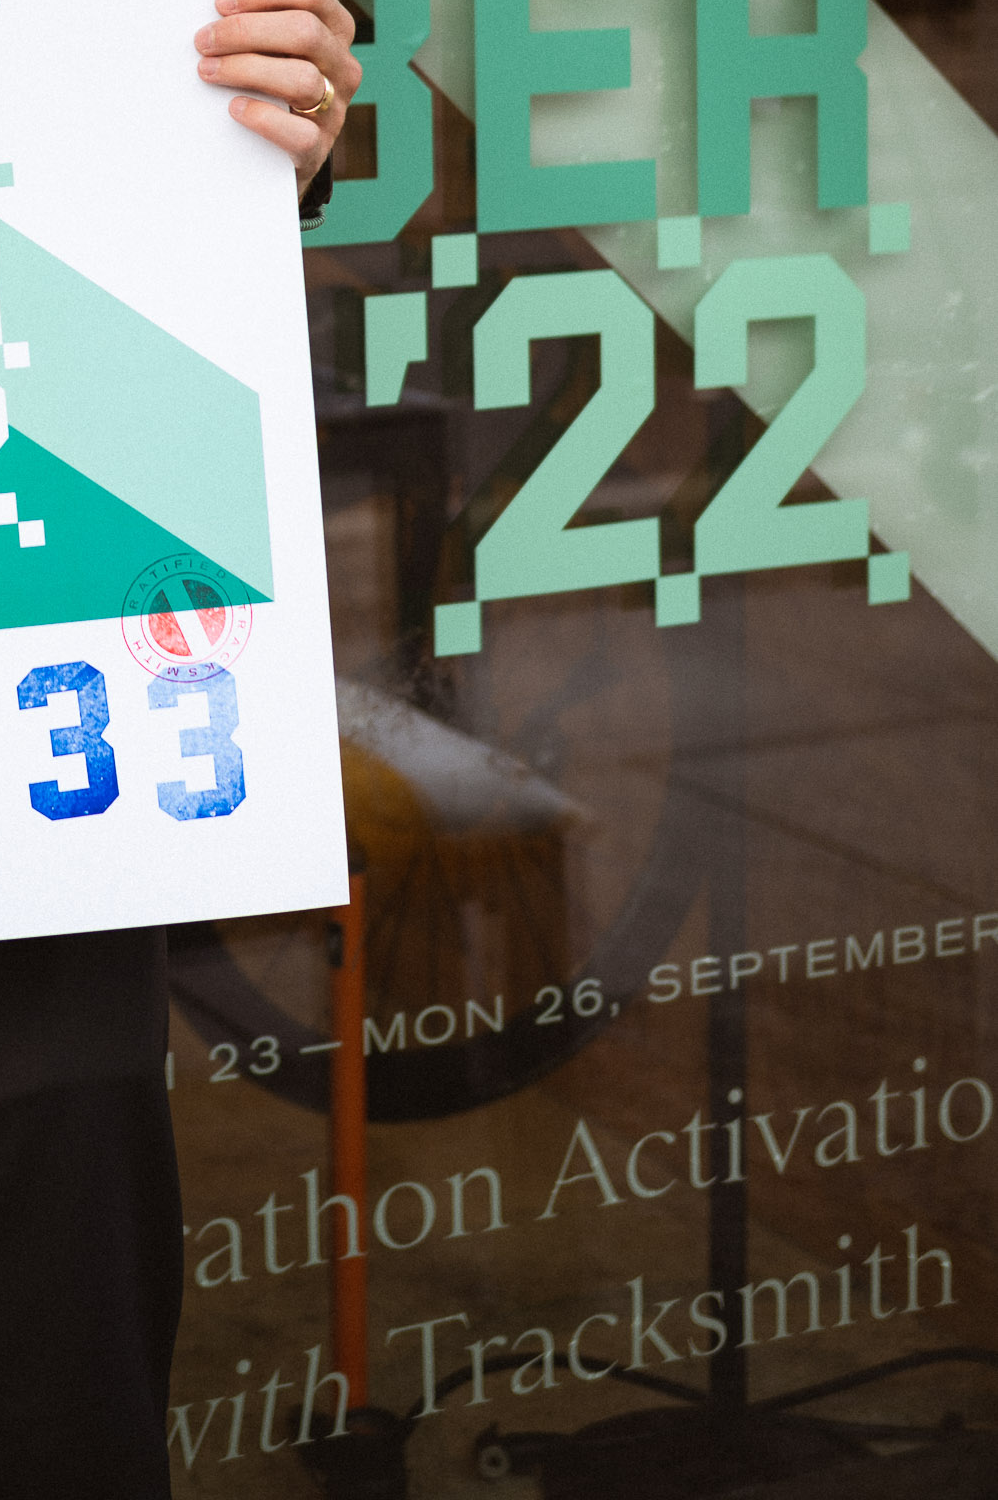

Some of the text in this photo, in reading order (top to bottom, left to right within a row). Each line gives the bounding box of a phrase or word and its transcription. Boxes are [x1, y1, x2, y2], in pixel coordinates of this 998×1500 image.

[129, 559, 227, 610] RATIFIED
[132, 603, 247, 677] TRACKSMITH
[363, 996, 506, 1056] MON
[534, 978, 621, 1026] 26,
[648, 912, 998, 1004] SEPTEMBER
[183, 1166, 509, 1287] athon
[385, 1223, 958, 1420] Tracksmith
